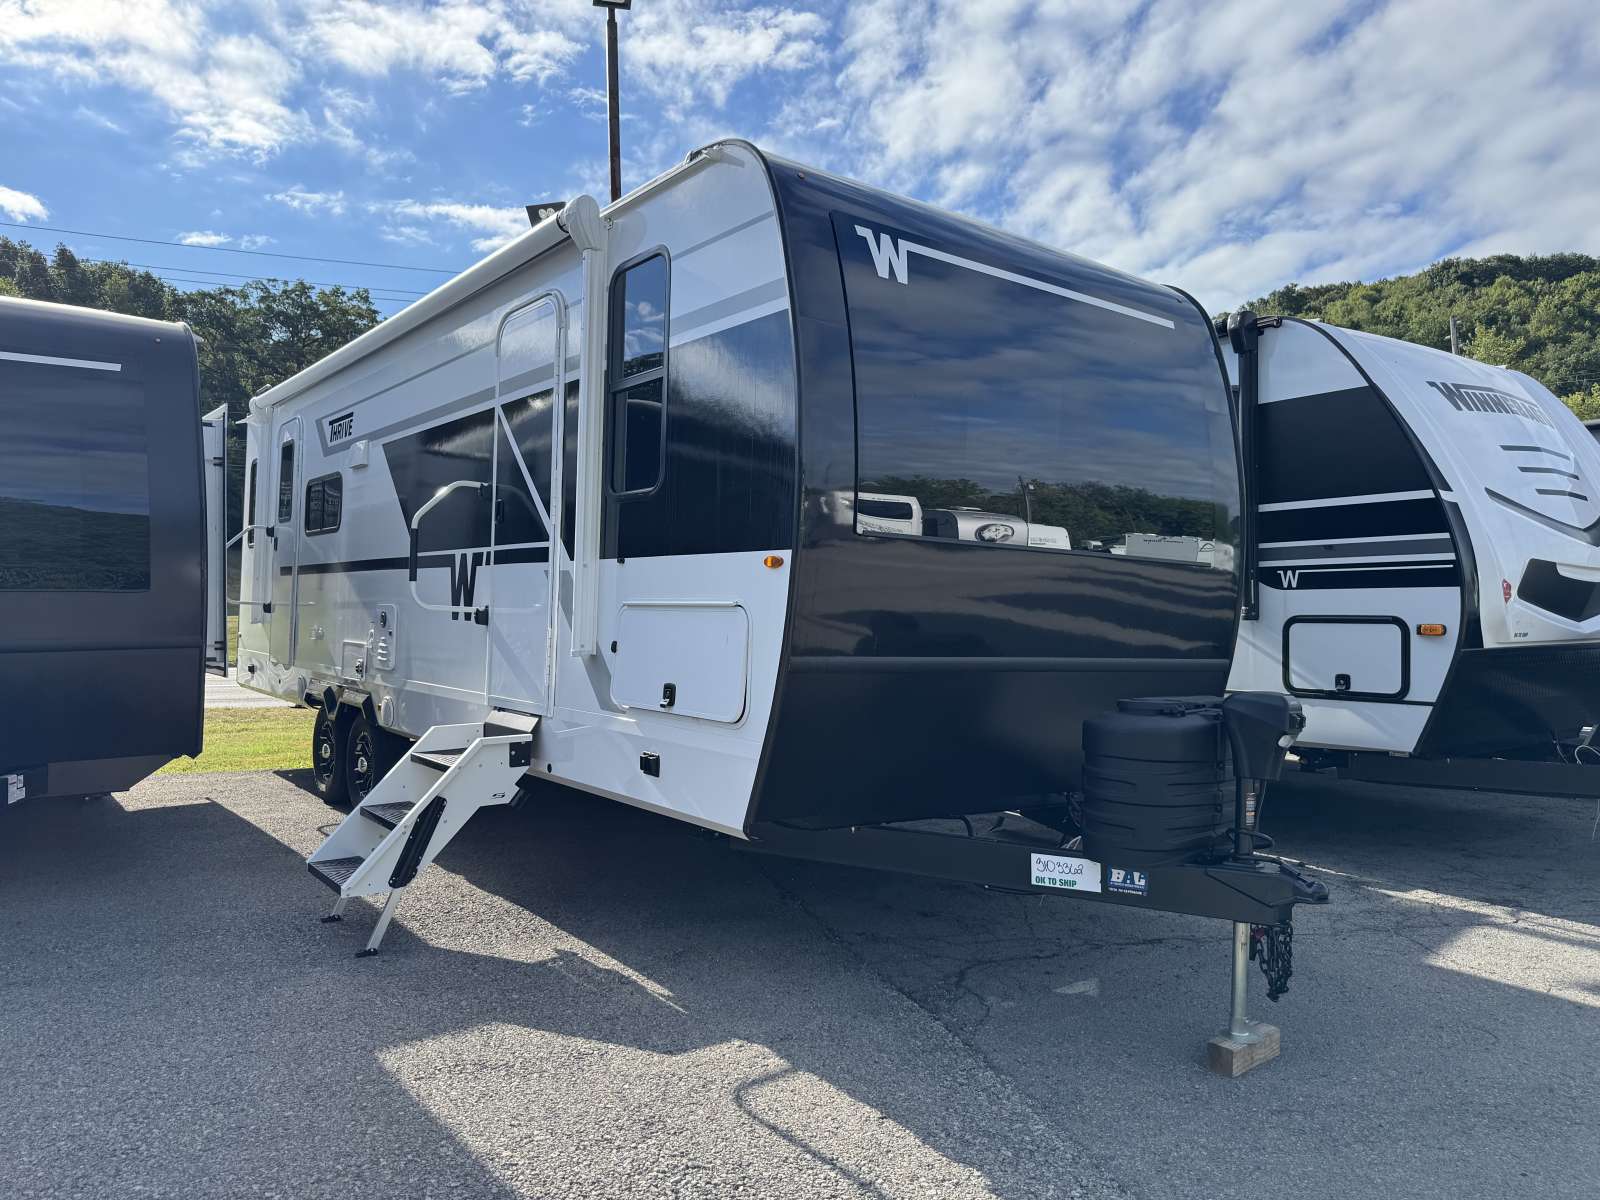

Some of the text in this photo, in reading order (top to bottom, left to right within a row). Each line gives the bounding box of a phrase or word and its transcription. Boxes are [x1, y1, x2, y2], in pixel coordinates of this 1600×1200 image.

[854, 225, 908, 285] W
[329, 411, 354, 443] THRIVE
[449, 551, 478, 622] W
[1277, 569, 1300, 588] W
[1035, 875, 1077, 888] OK TO SHIP
